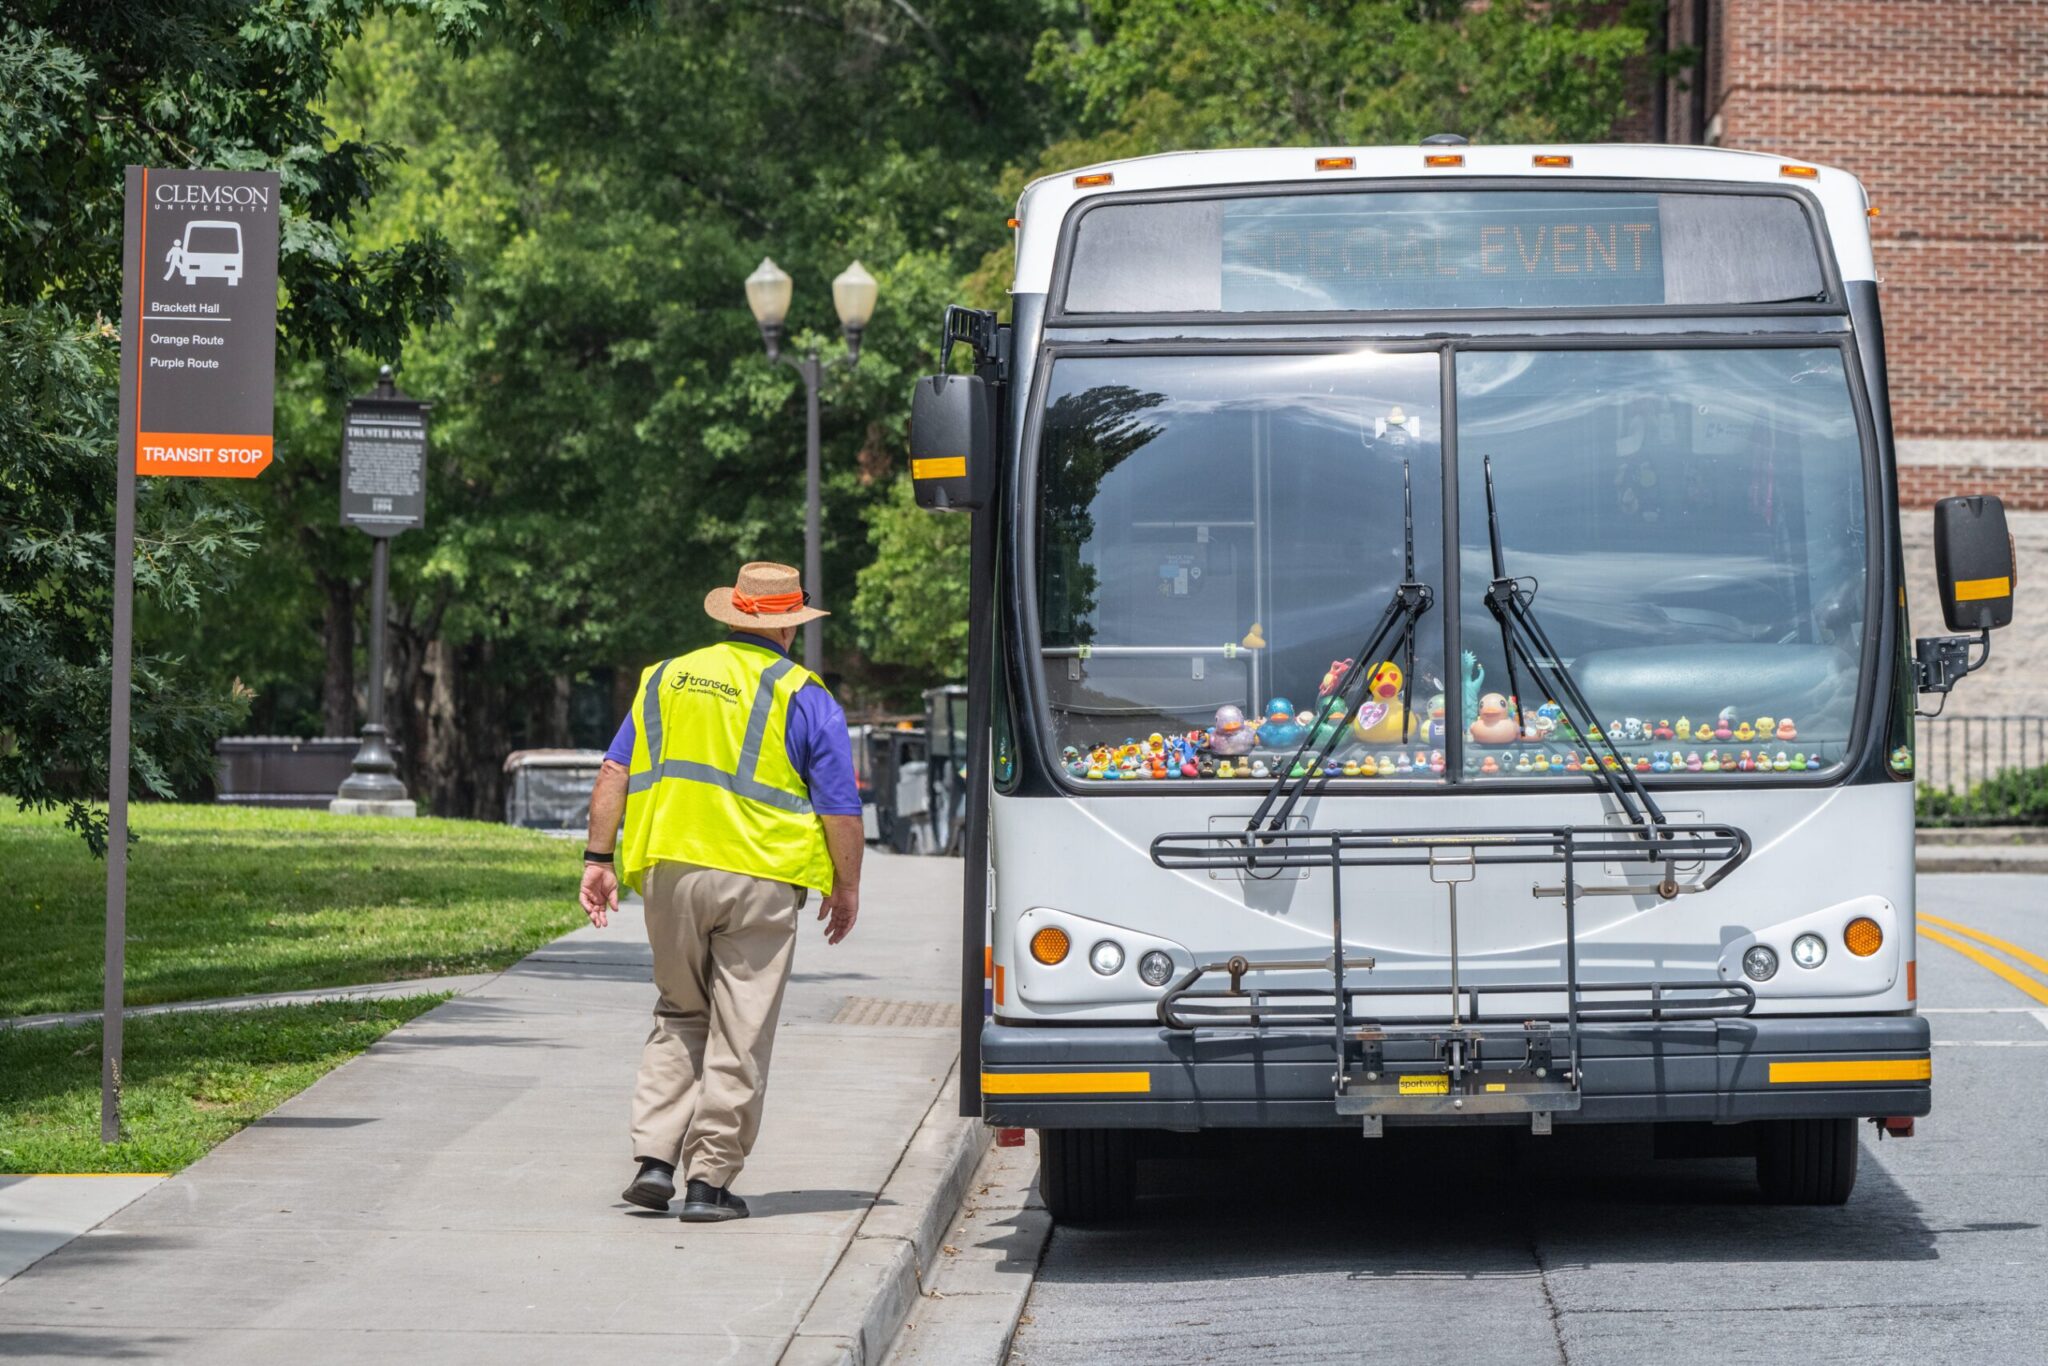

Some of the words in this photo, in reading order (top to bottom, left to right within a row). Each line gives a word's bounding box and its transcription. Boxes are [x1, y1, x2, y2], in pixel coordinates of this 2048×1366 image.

[155, 184, 269, 205] CLEMSON
[154, 203, 268, 213] UNIVERSITY
[1481, 224, 1652, 273] EVENT
[151, 302, 197, 313] Brackett
[199, 303, 220, 313] Hall
[150, 333, 190, 347] Orange
[192, 334, 224, 346] Route
[150, 357, 185, 370] Purple
[187, 358, 219, 369] Route
[143, 447, 215, 463] TRANSIT
[217, 448, 263, 464] STOP
[689, 676, 742, 697] transdev
